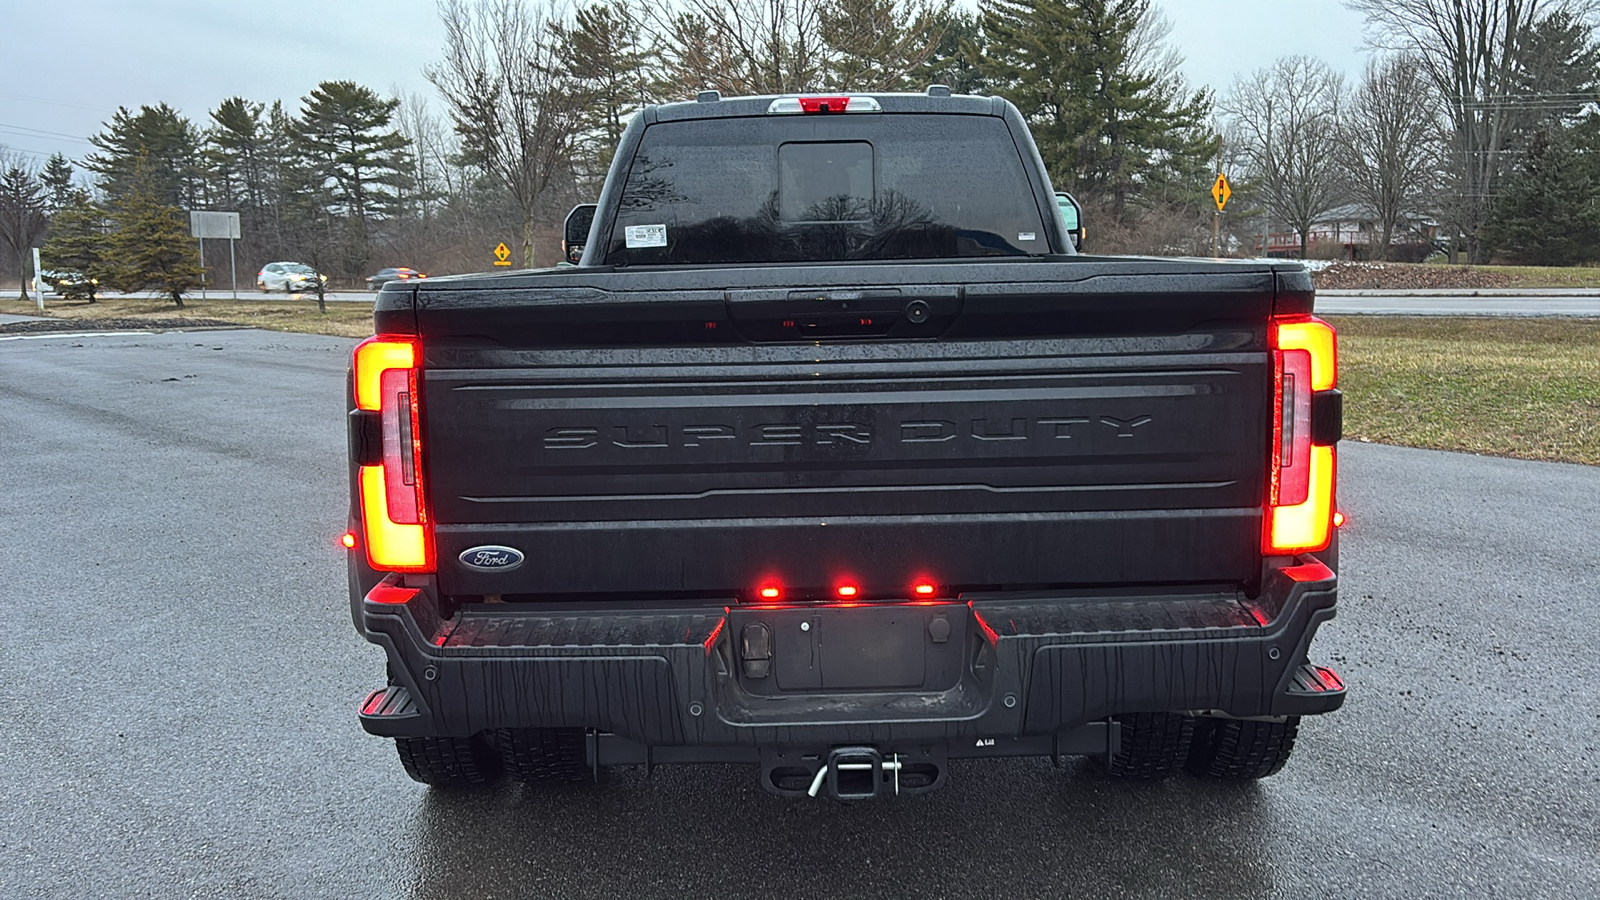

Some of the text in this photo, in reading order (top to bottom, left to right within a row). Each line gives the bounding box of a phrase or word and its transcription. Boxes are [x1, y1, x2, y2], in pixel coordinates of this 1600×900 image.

[543, 415, 1153, 449] SUPER DUTY
[473, 551, 509, 566] Ford
